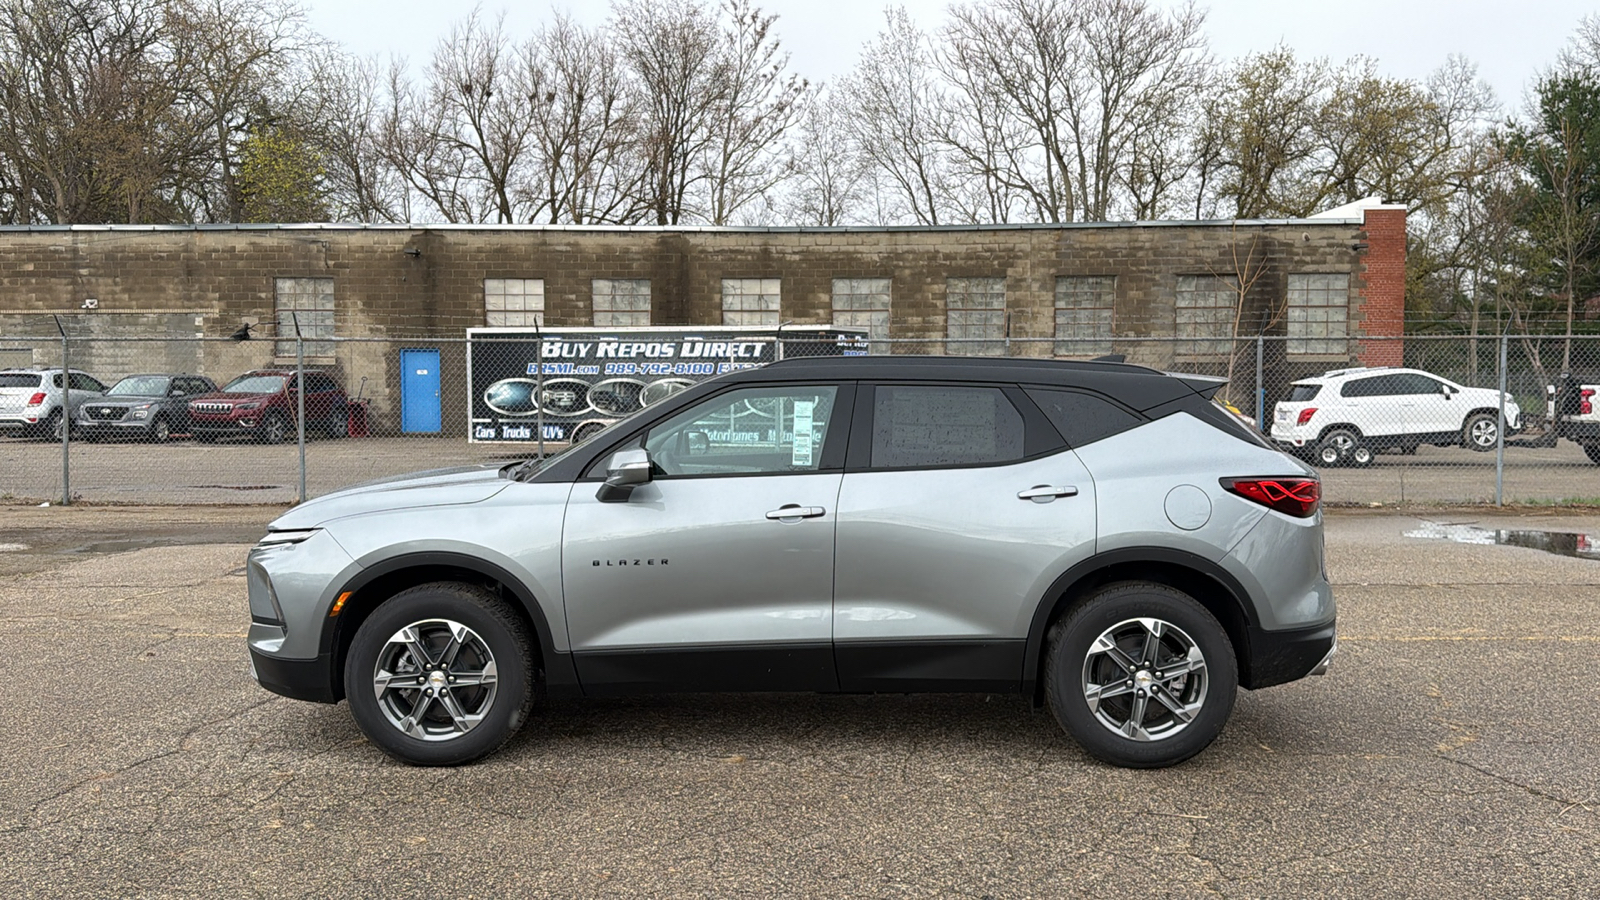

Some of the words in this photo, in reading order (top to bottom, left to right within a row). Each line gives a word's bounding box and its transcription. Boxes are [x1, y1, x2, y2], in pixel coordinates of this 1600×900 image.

[595, 337, 676, 358] REPOS
[680, 337, 767, 358] DIRECT
[604, 362, 714, 375] 989-792-8100
[475, 426, 496, 438] Cars
[502, 426, 531, 439] Trucks
[541, 426, 564, 439] UV's
[592, 559, 669, 567] BLAZER
